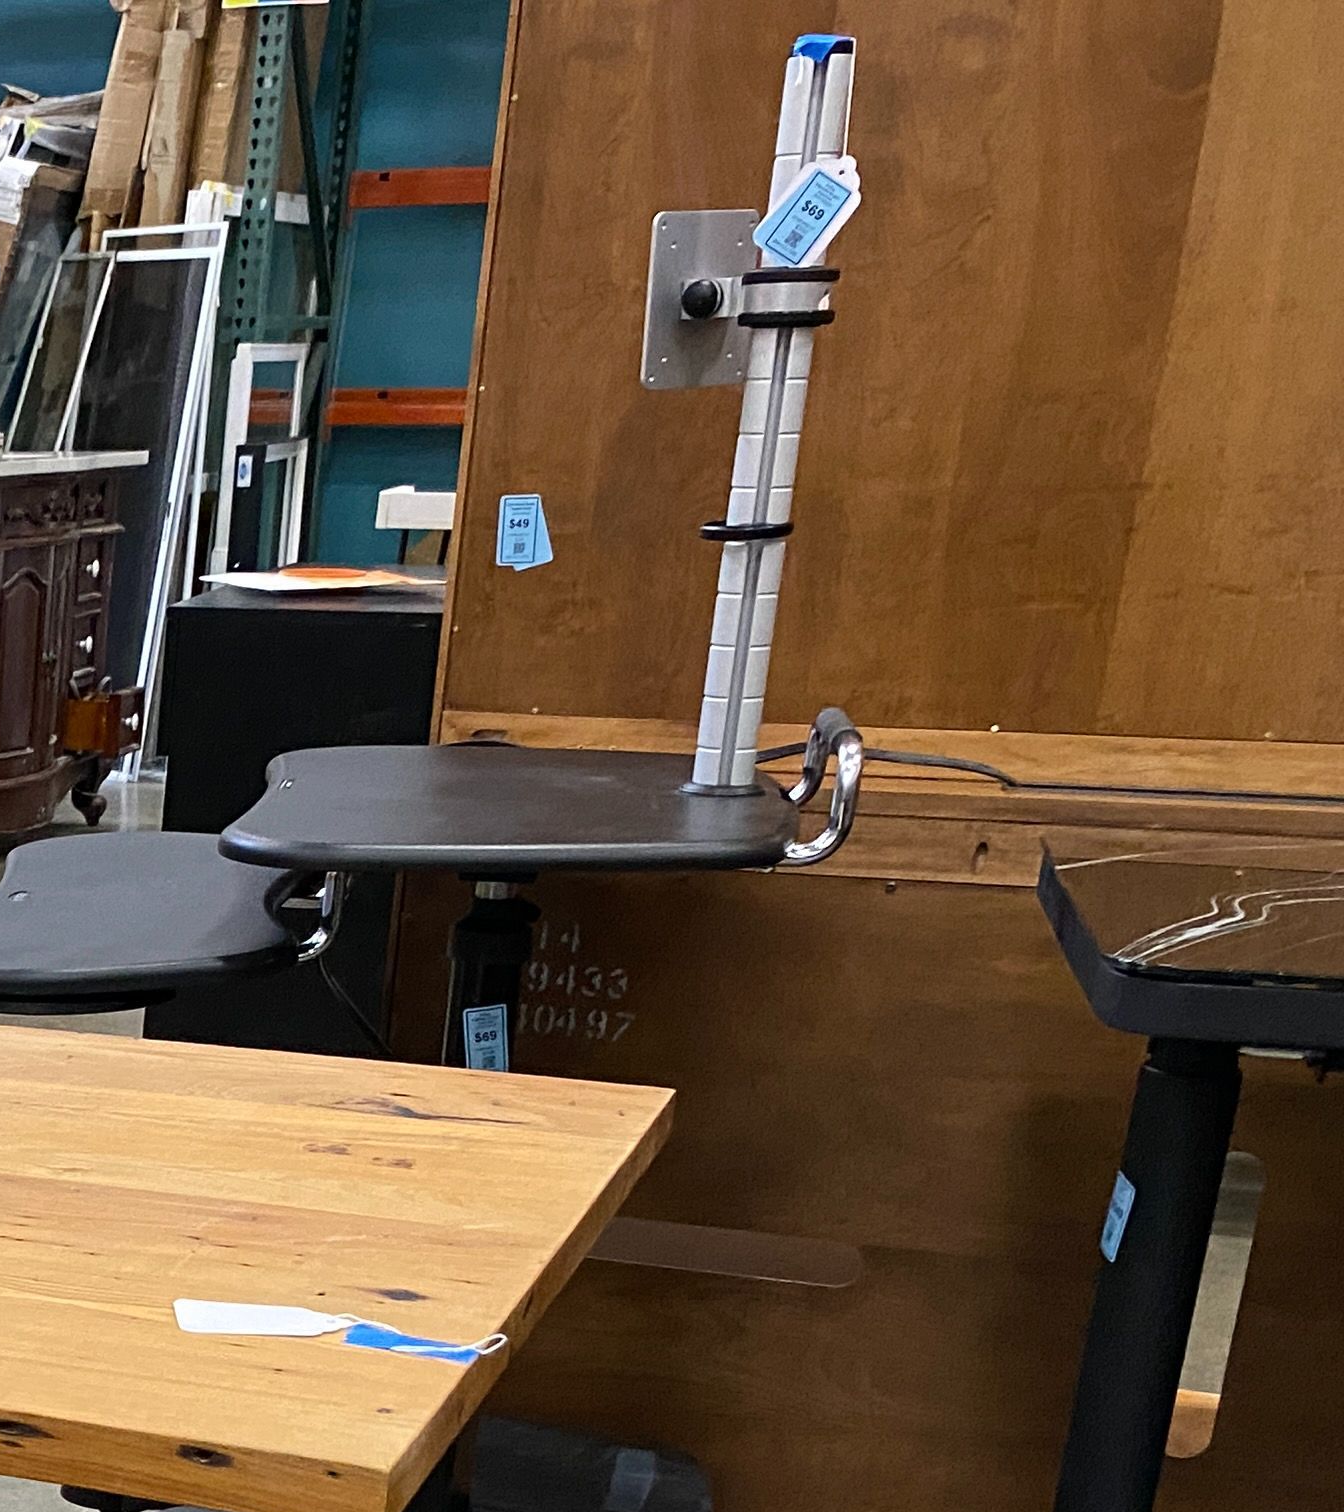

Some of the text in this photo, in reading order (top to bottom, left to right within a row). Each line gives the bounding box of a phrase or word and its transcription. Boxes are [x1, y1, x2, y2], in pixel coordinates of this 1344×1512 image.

[801, 199, 825, 221] $69
[509, 518, 530, 530] $49
[474, 1030, 498, 1043] $69
